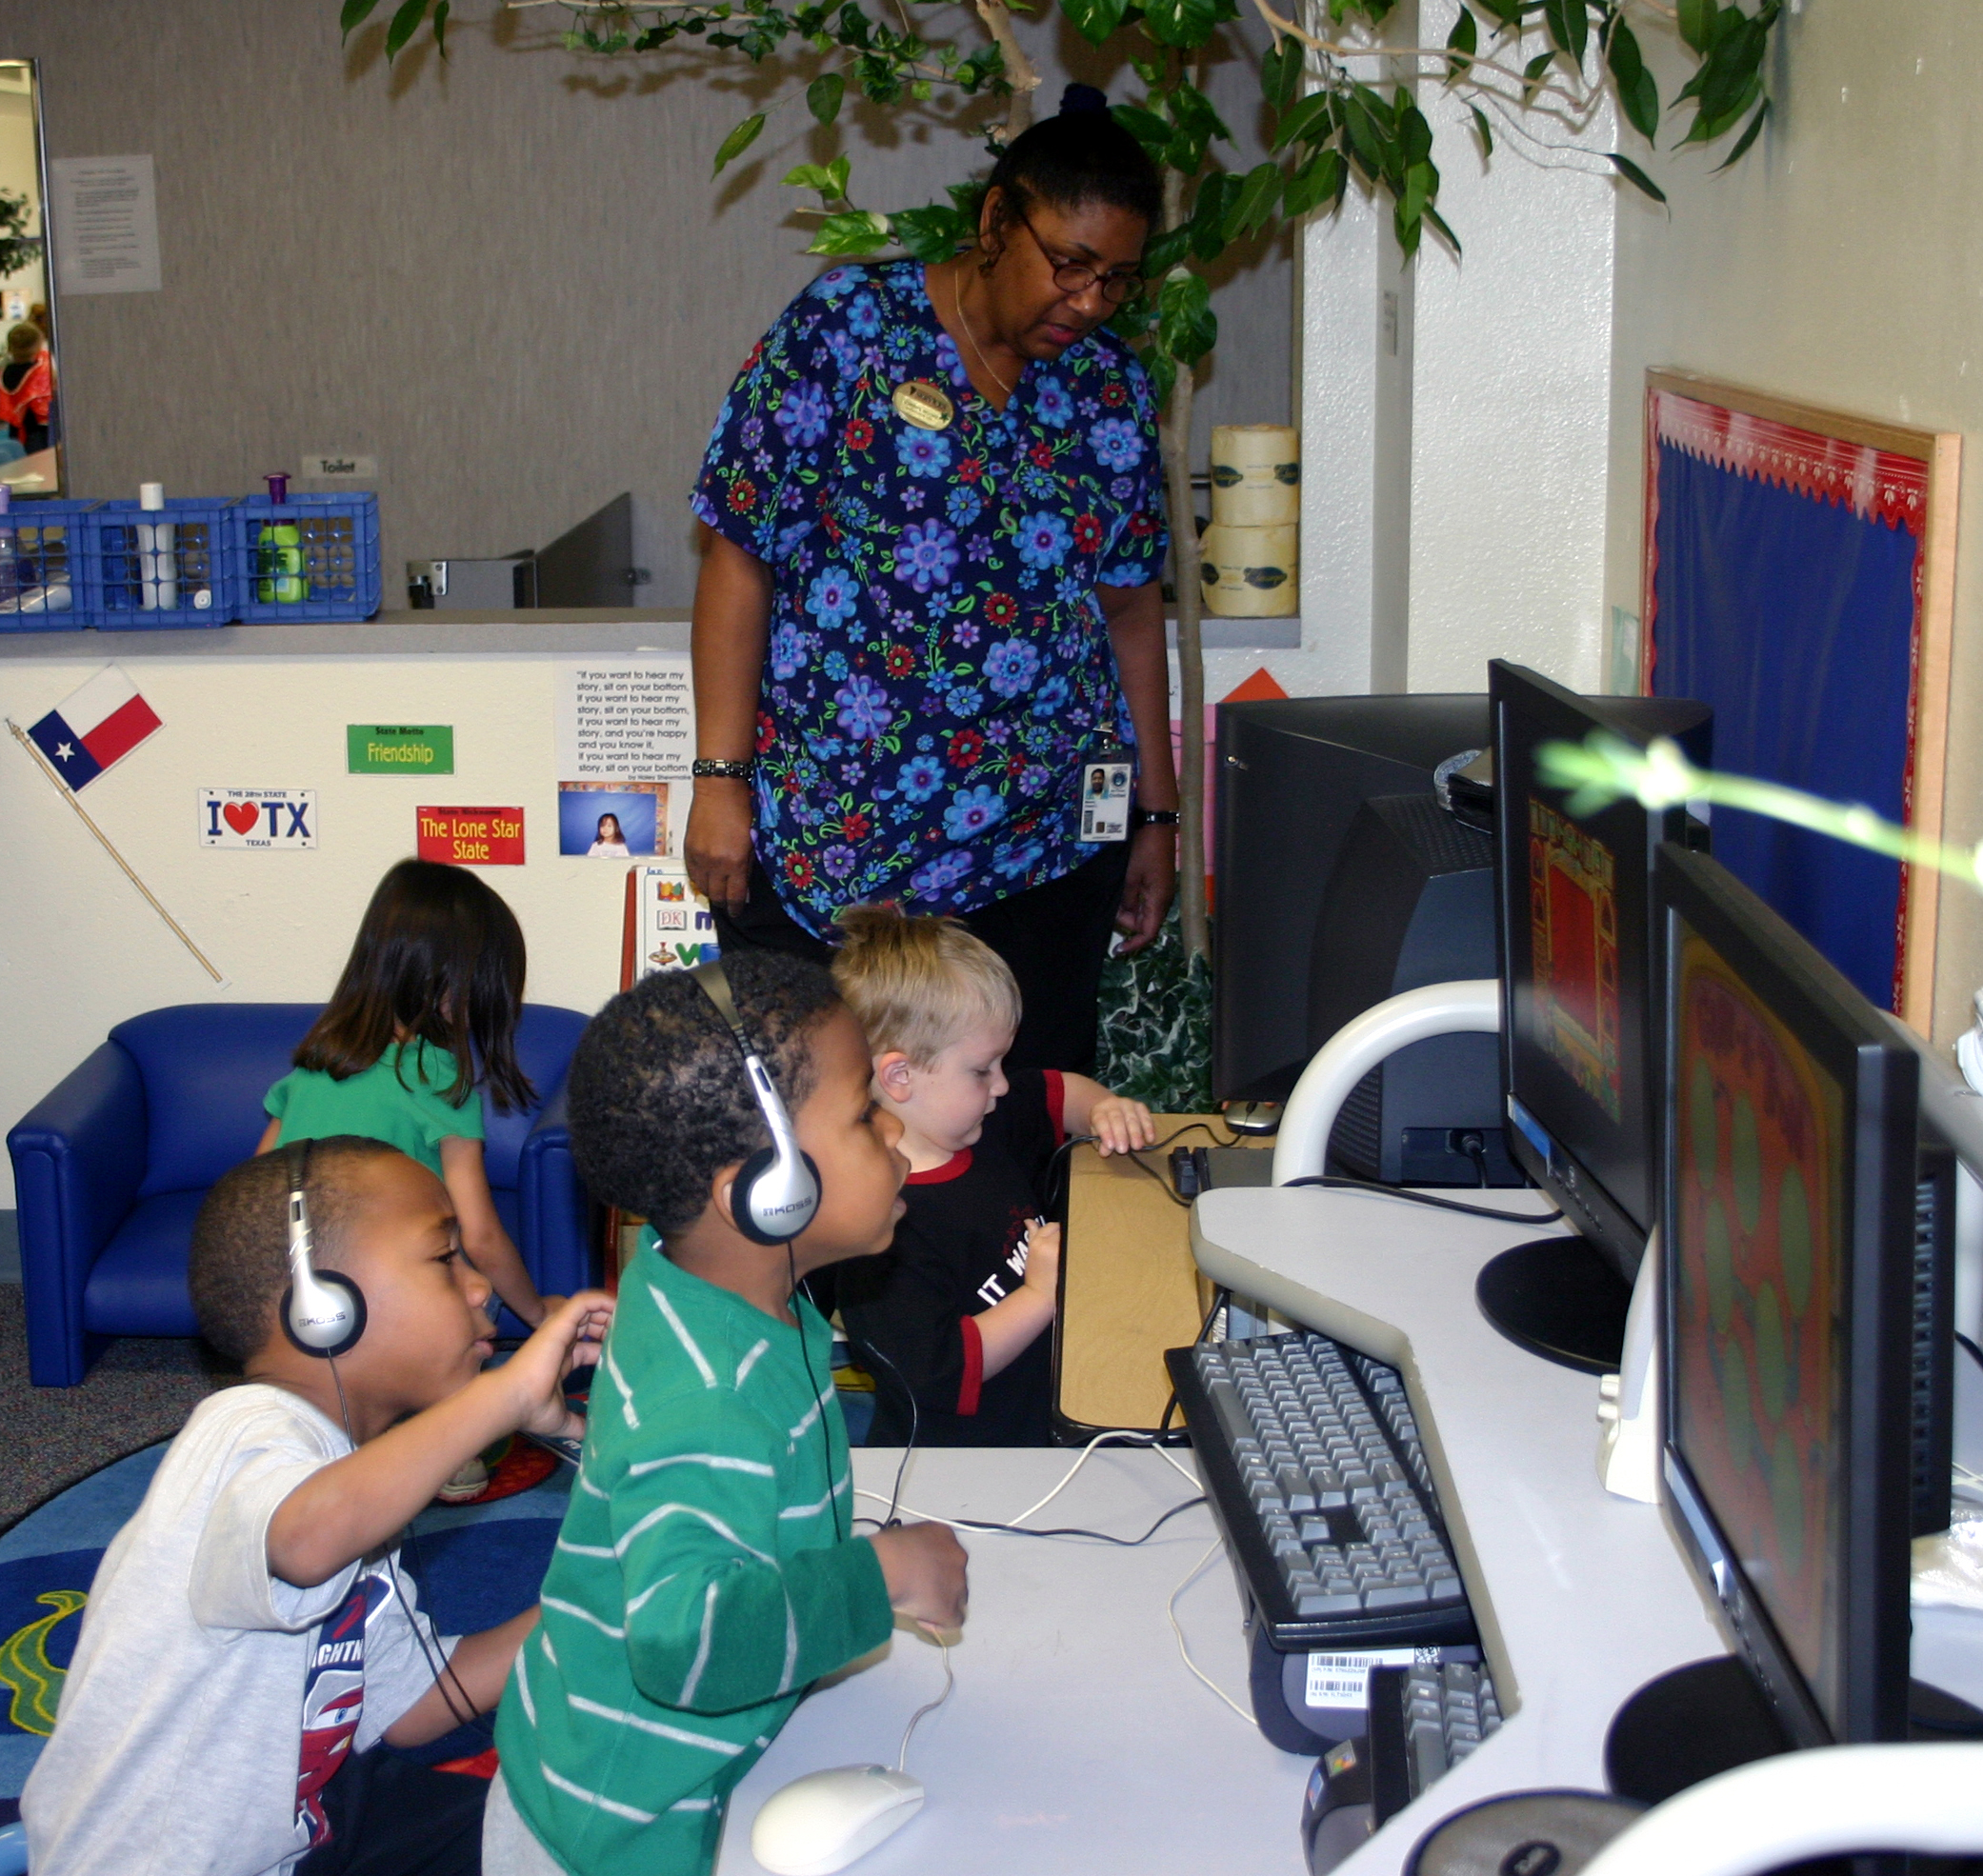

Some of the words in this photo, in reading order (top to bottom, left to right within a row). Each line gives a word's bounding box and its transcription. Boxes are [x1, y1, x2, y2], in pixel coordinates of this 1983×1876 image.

[320, 459, 355, 473] Toilet
[589, 672, 607, 681] you
[669, 672, 684, 681] my
[576, 683, 601, 692] story,
[652, 683, 689, 692] bottom,
[585, 695, 602, 704] you
[665, 695, 680, 704] my
[577, 707, 602, 715] story,
[653, 707, 690, 715] bottom,
[578, 729, 602, 739] story,
[626, 729, 655, 739] you're
[657, 729, 687, 739] happy
[368, 743, 434, 765] Friendship
[578, 764, 604, 772] story,
[207, 801, 222, 836] I
[261, 802, 311, 838] TX
[420, 818, 448, 838] The
[451, 819, 488, 838] Lone
[491, 819, 521, 838] Star
[452, 840, 490, 860] State
[774, 1196, 812, 1216] KOSS
[976, 1273, 1007, 1307] IT
